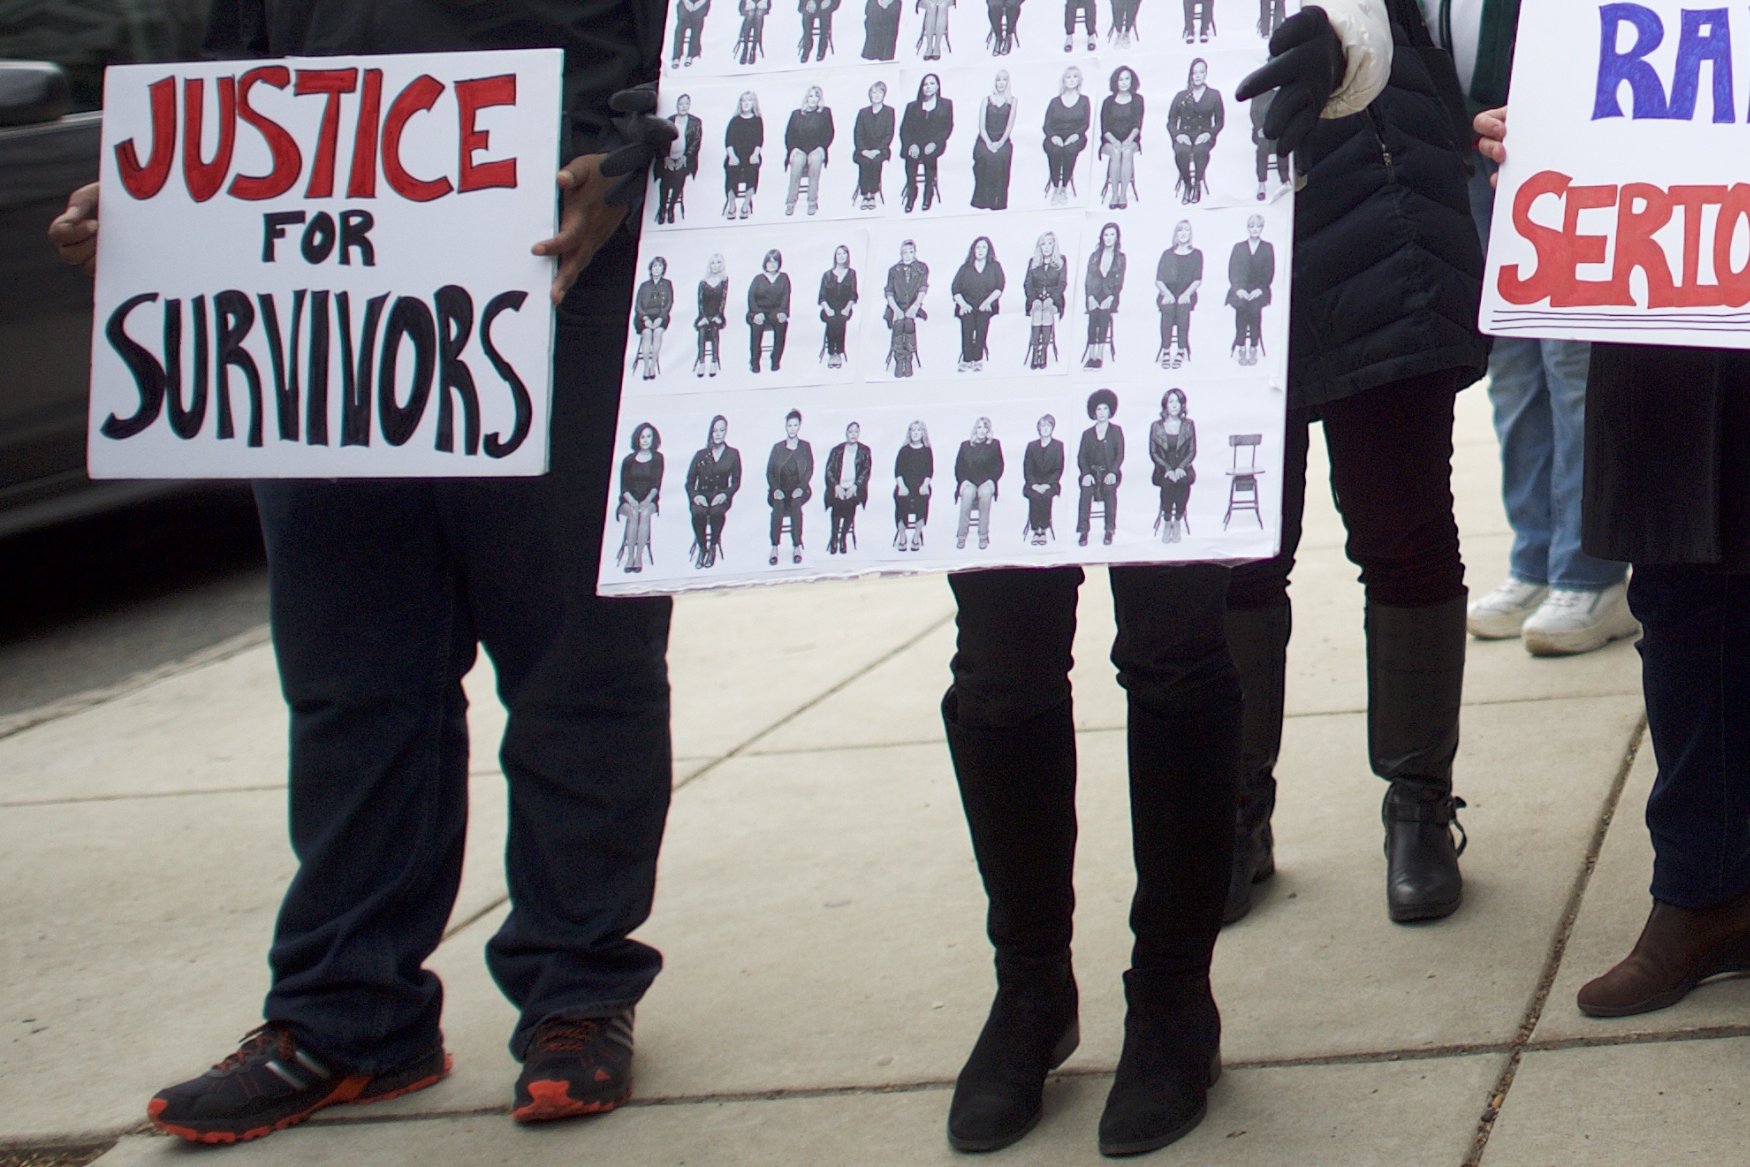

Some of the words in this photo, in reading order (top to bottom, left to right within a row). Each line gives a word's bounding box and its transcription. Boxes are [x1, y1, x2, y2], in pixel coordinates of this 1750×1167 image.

[113, 65, 518, 203] JUSTICE
[261, 209, 376, 266] FOR
[99, 284, 533, 459] SURVIVORS
